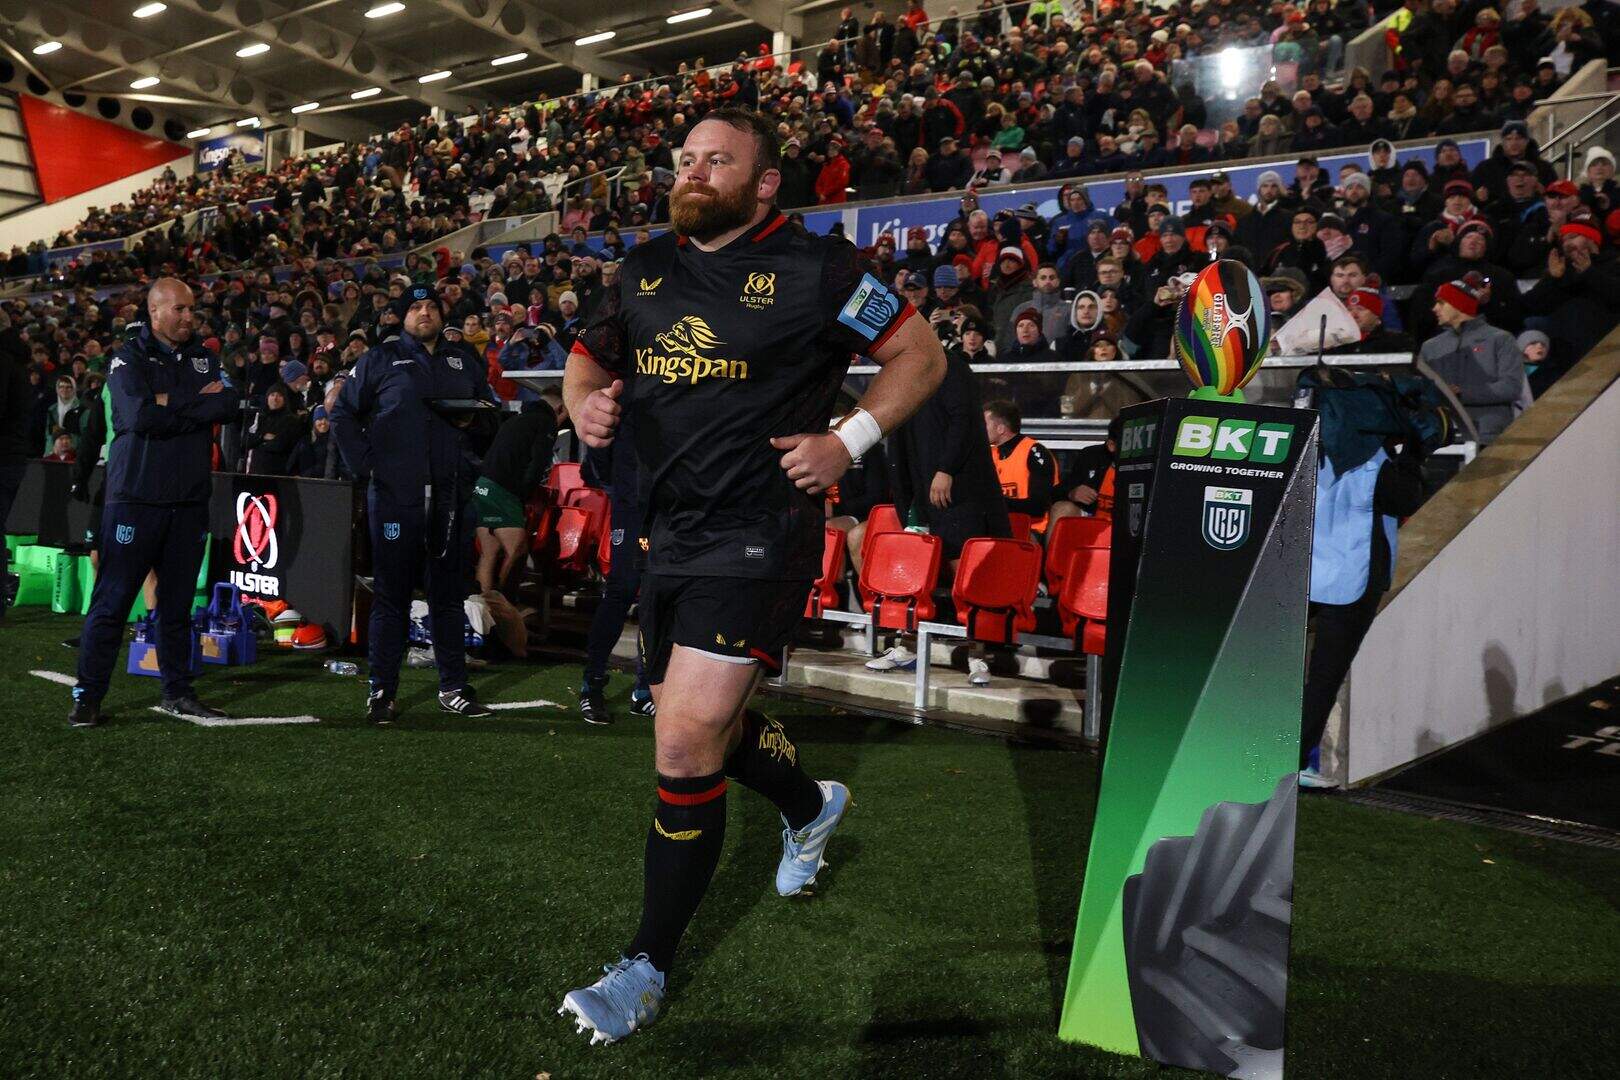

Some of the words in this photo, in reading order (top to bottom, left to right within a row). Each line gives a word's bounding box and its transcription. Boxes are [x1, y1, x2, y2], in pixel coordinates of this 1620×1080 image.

[739, 295, 774, 305] ULSTER
[746, 302, 765, 311] Rugby
[1210, 293, 1224, 348] GILBERT
[634, 347, 748, 385] Kingspan
[1121, 423, 1156, 451] BKT
[1177, 422, 1290, 457] BKT
[1170, 462, 1223, 474] GROWING
[1225, 466, 1284, 479] TOGETHER
[1214, 489, 1243, 501] BKT
[230, 570, 279, 597] ULSTER
